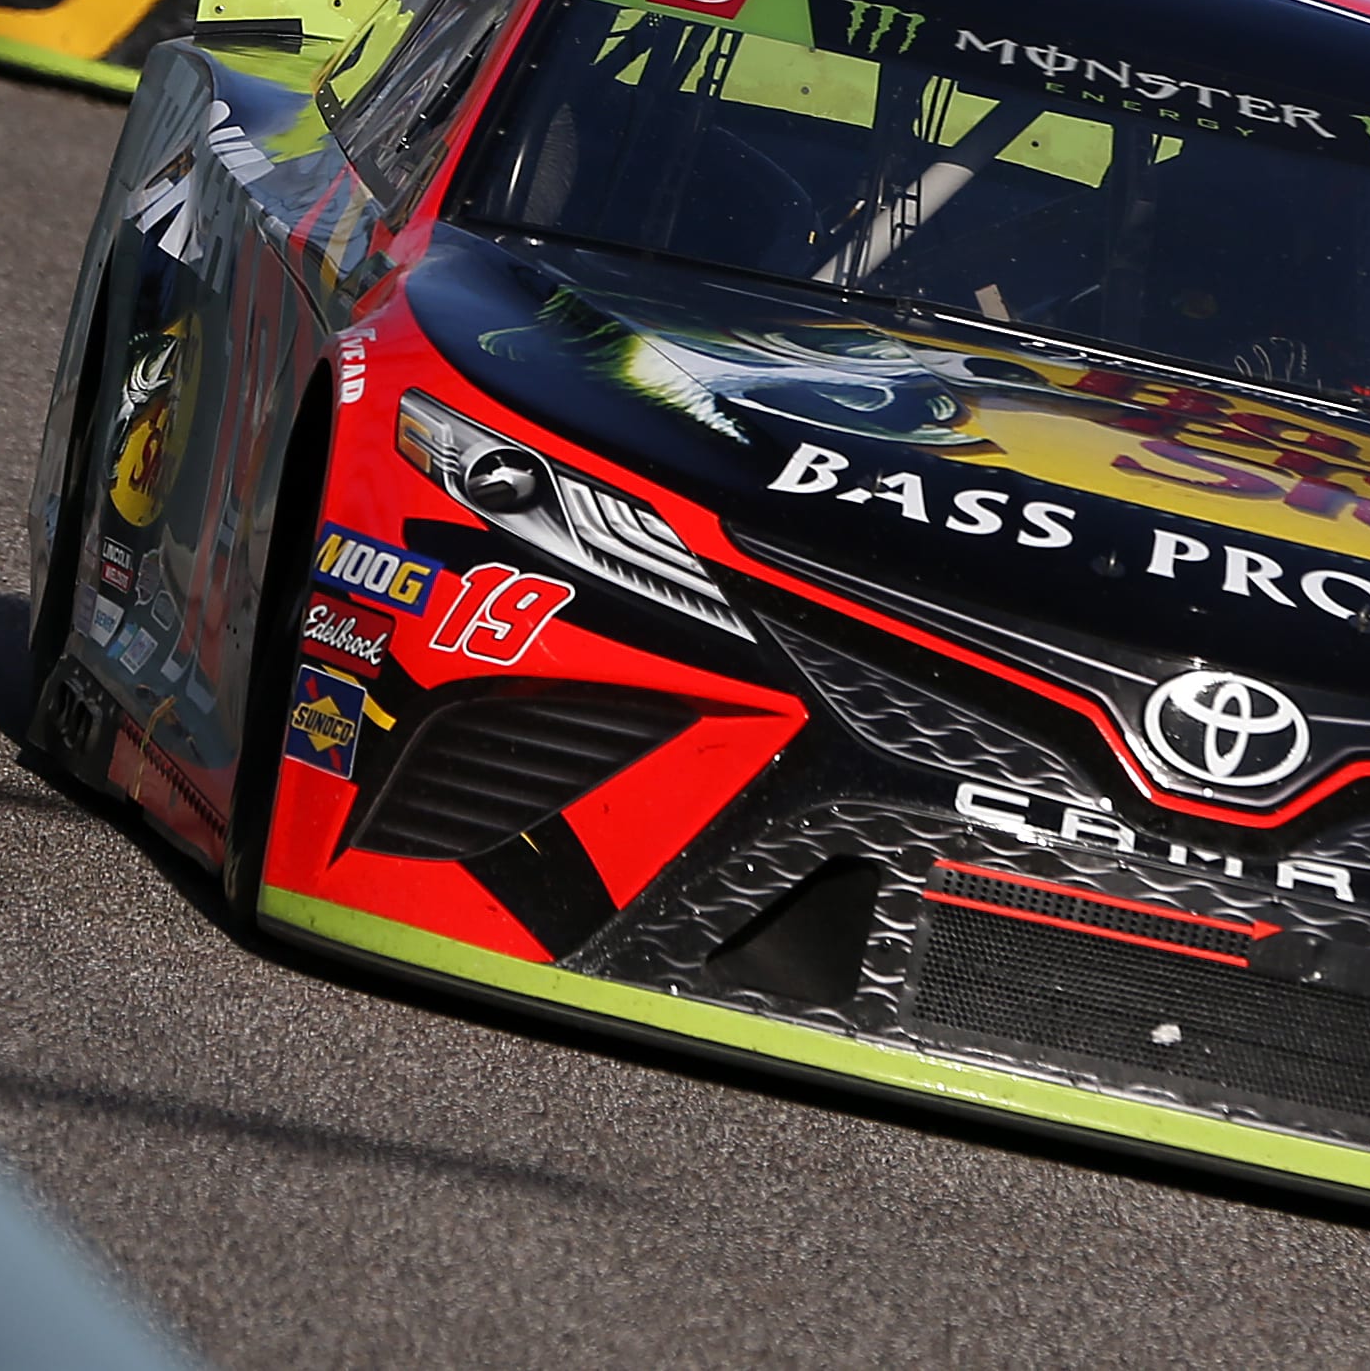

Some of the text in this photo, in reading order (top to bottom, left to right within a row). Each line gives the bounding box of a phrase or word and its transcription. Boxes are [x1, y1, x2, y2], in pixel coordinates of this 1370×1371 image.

[953, 29, 1337, 140] MONSTER
[1045, 80, 1255, 138] ENERGY
[766, 442, 1077, 549] BASS
[315, 533, 432, 605] MOOG
[303, 604, 388, 666] Edelbrock
[429, 562, 576, 666] 19
[293, 705, 354, 744] SUNOCO
